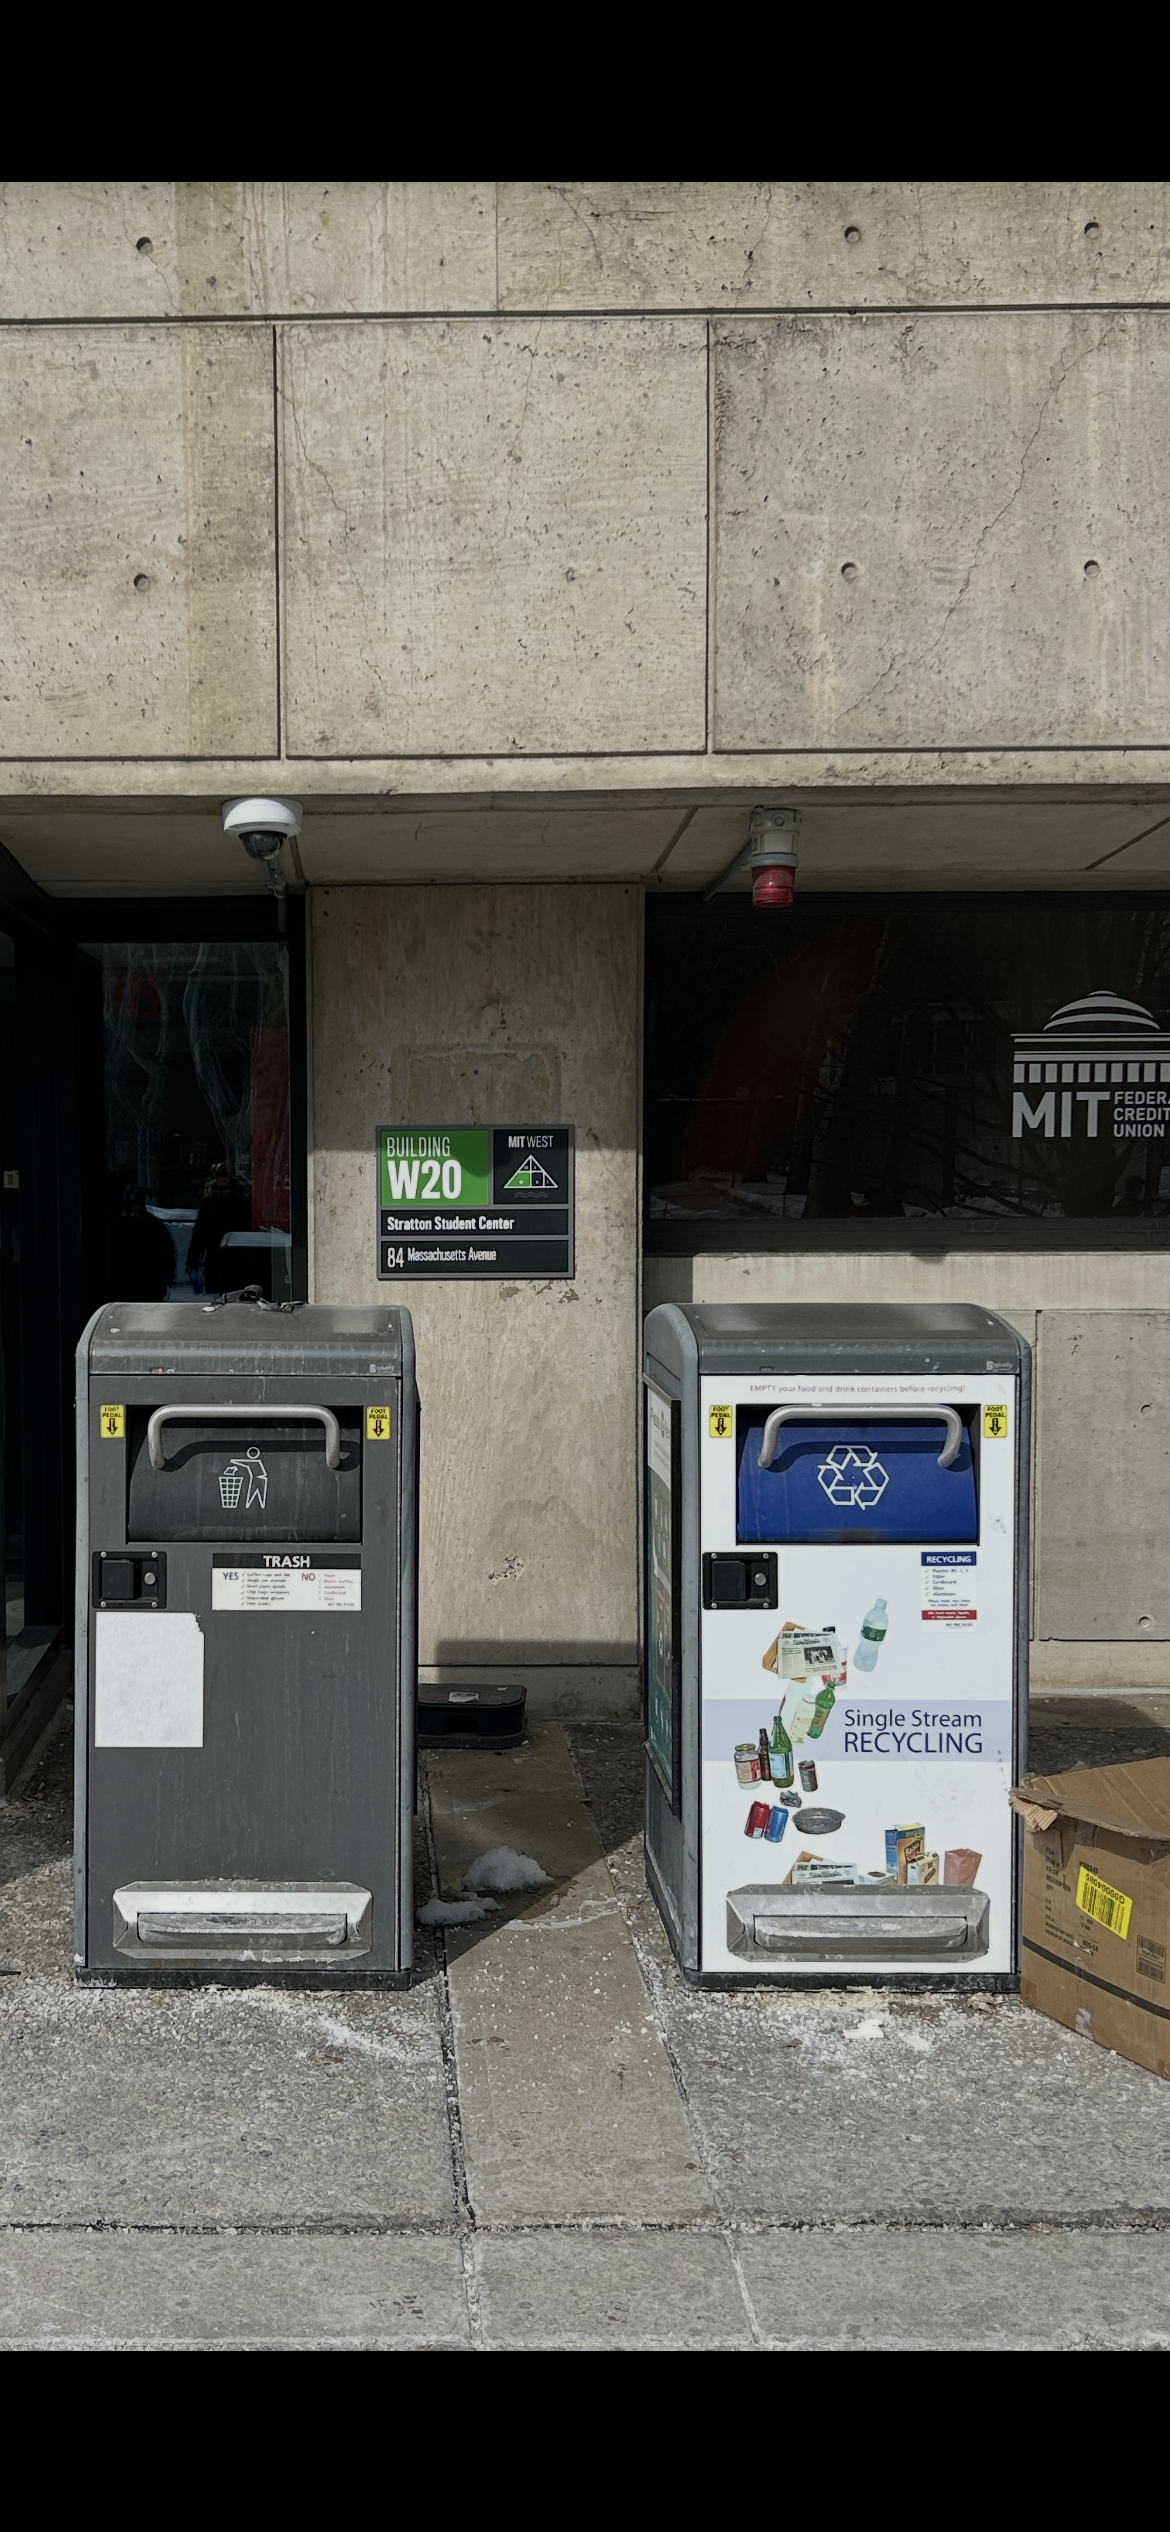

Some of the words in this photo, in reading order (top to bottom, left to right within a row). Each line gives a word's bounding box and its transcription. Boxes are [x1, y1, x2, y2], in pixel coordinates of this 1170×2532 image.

[1114, 1091, 1170, 1104] FEDER
[1012, 1091, 1110, 1138] MIT
[1114, 1124, 1164, 1137] UNION
[386, 1136, 450, 1158] BUILDING
[508, 1136, 525, 1148] MIT
[526, 1136, 554, 1148] WEST
[387, 1160, 462, 1200] W20
[387, 1216, 432, 1230] Stratton
[434, 1216, 476, 1230] Student
[478, 1216, 514, 1230] Center
[387, 1247, 404, 1268] 84
[408, 1247, 466, 1261] Massachusetts
[468, 1247, 497, 1261] Avenue
[263, 1556, 311, 1567] TRASH
[223, 1572, 239, 1580] YES
[302, 1573, 315, 1581] NO
[844, 1709, 905, 1731] Single
[912, 1709, 982, 1727] Stream
[844, 1732, 982, 1753] RECYCLING
